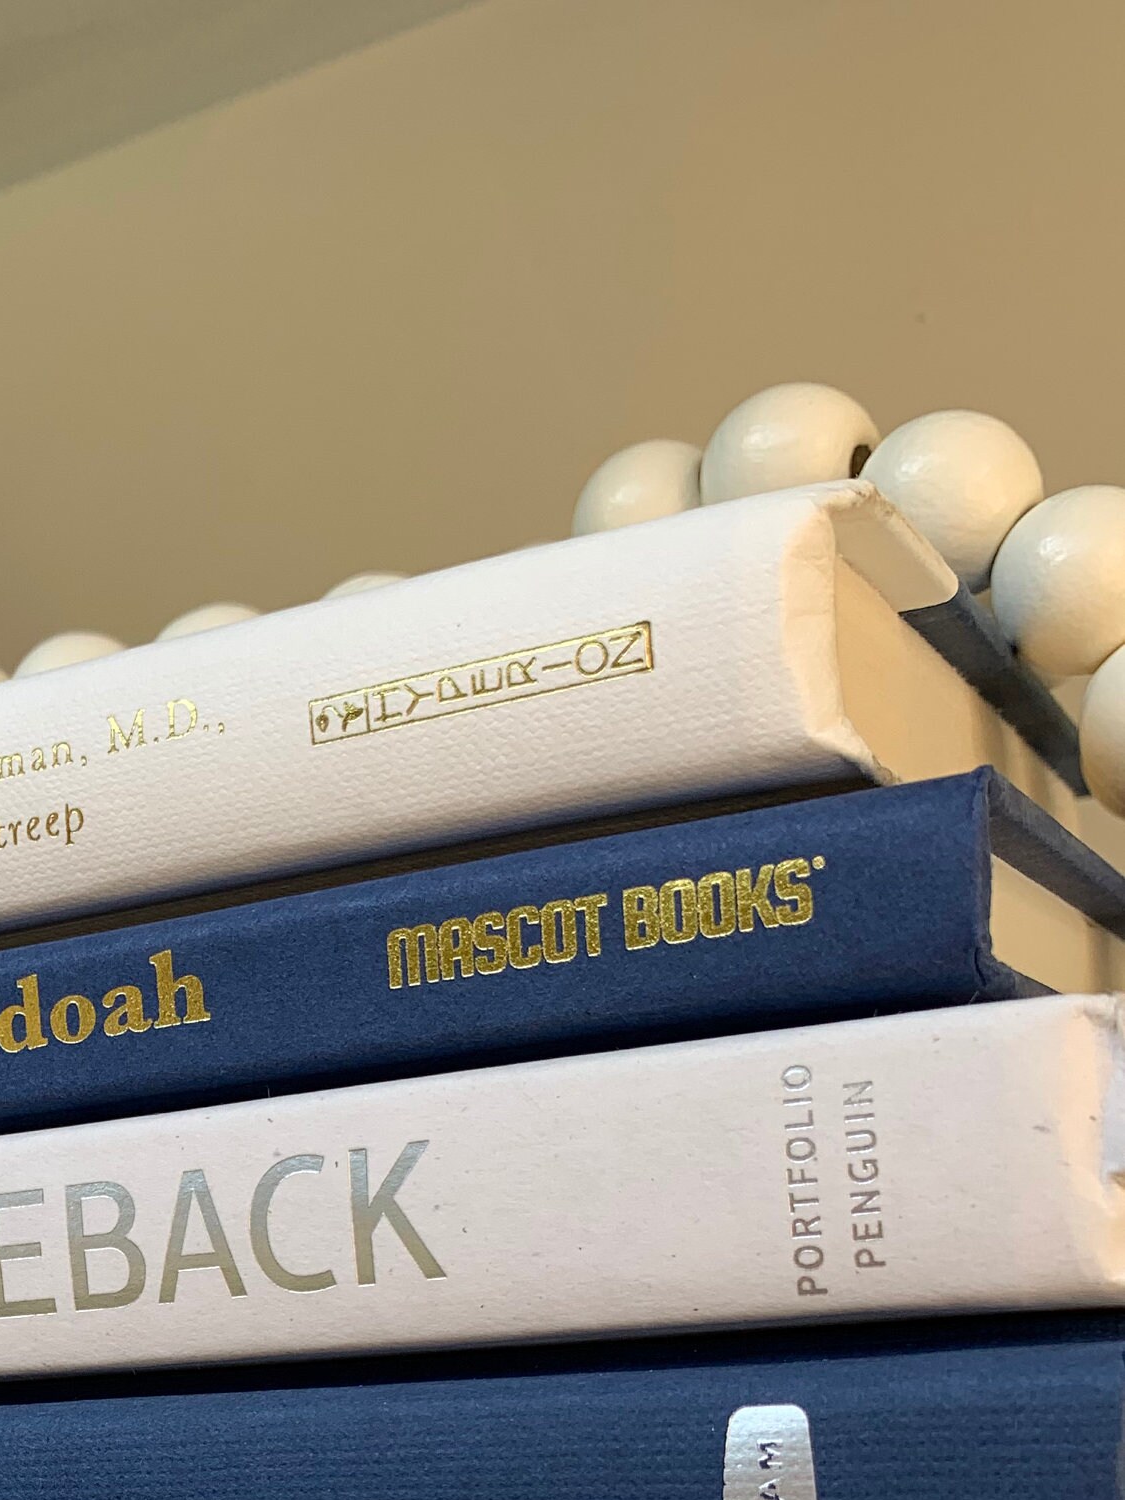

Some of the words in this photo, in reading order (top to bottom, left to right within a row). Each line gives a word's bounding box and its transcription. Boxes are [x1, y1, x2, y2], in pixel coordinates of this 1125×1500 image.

[386, 893, 607, 990] MASCOT
[780, 1064, 828, 1296] PORTFOLIO
[842, 1080, 887, 1269] PENGUIN
